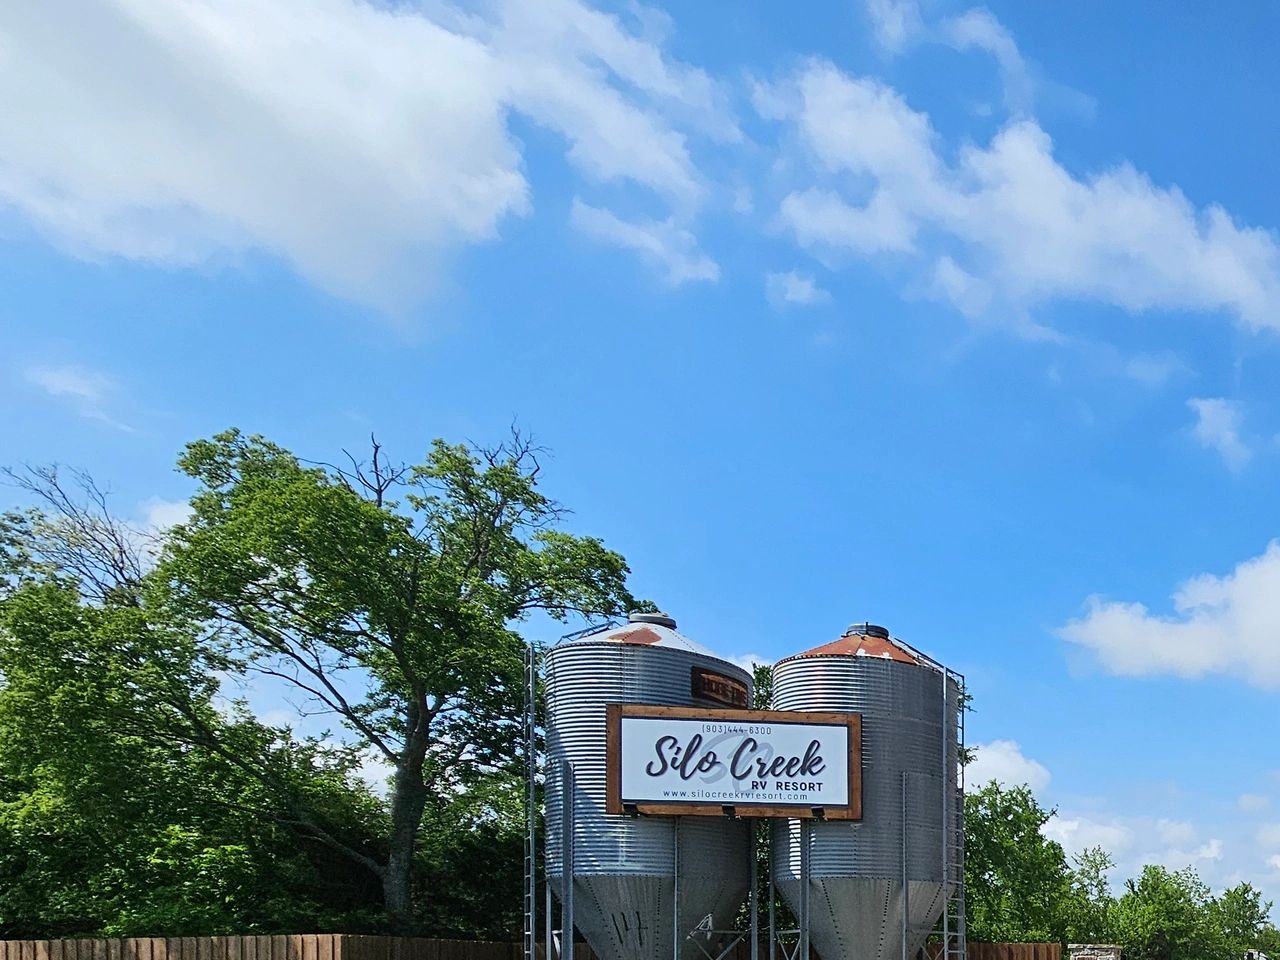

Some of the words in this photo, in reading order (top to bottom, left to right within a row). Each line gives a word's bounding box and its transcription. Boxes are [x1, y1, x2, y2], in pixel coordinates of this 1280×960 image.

[702, 724, 772, 735] (903)444-6300
[646, 733, 720, 781] Silo
[730, 737, 826, 781] Creek
[751, 780, 768, 790] RV
[776, 781, 823, 791] RESORT
[663, 789, 808, 801] www.silocreekrvresort.com
